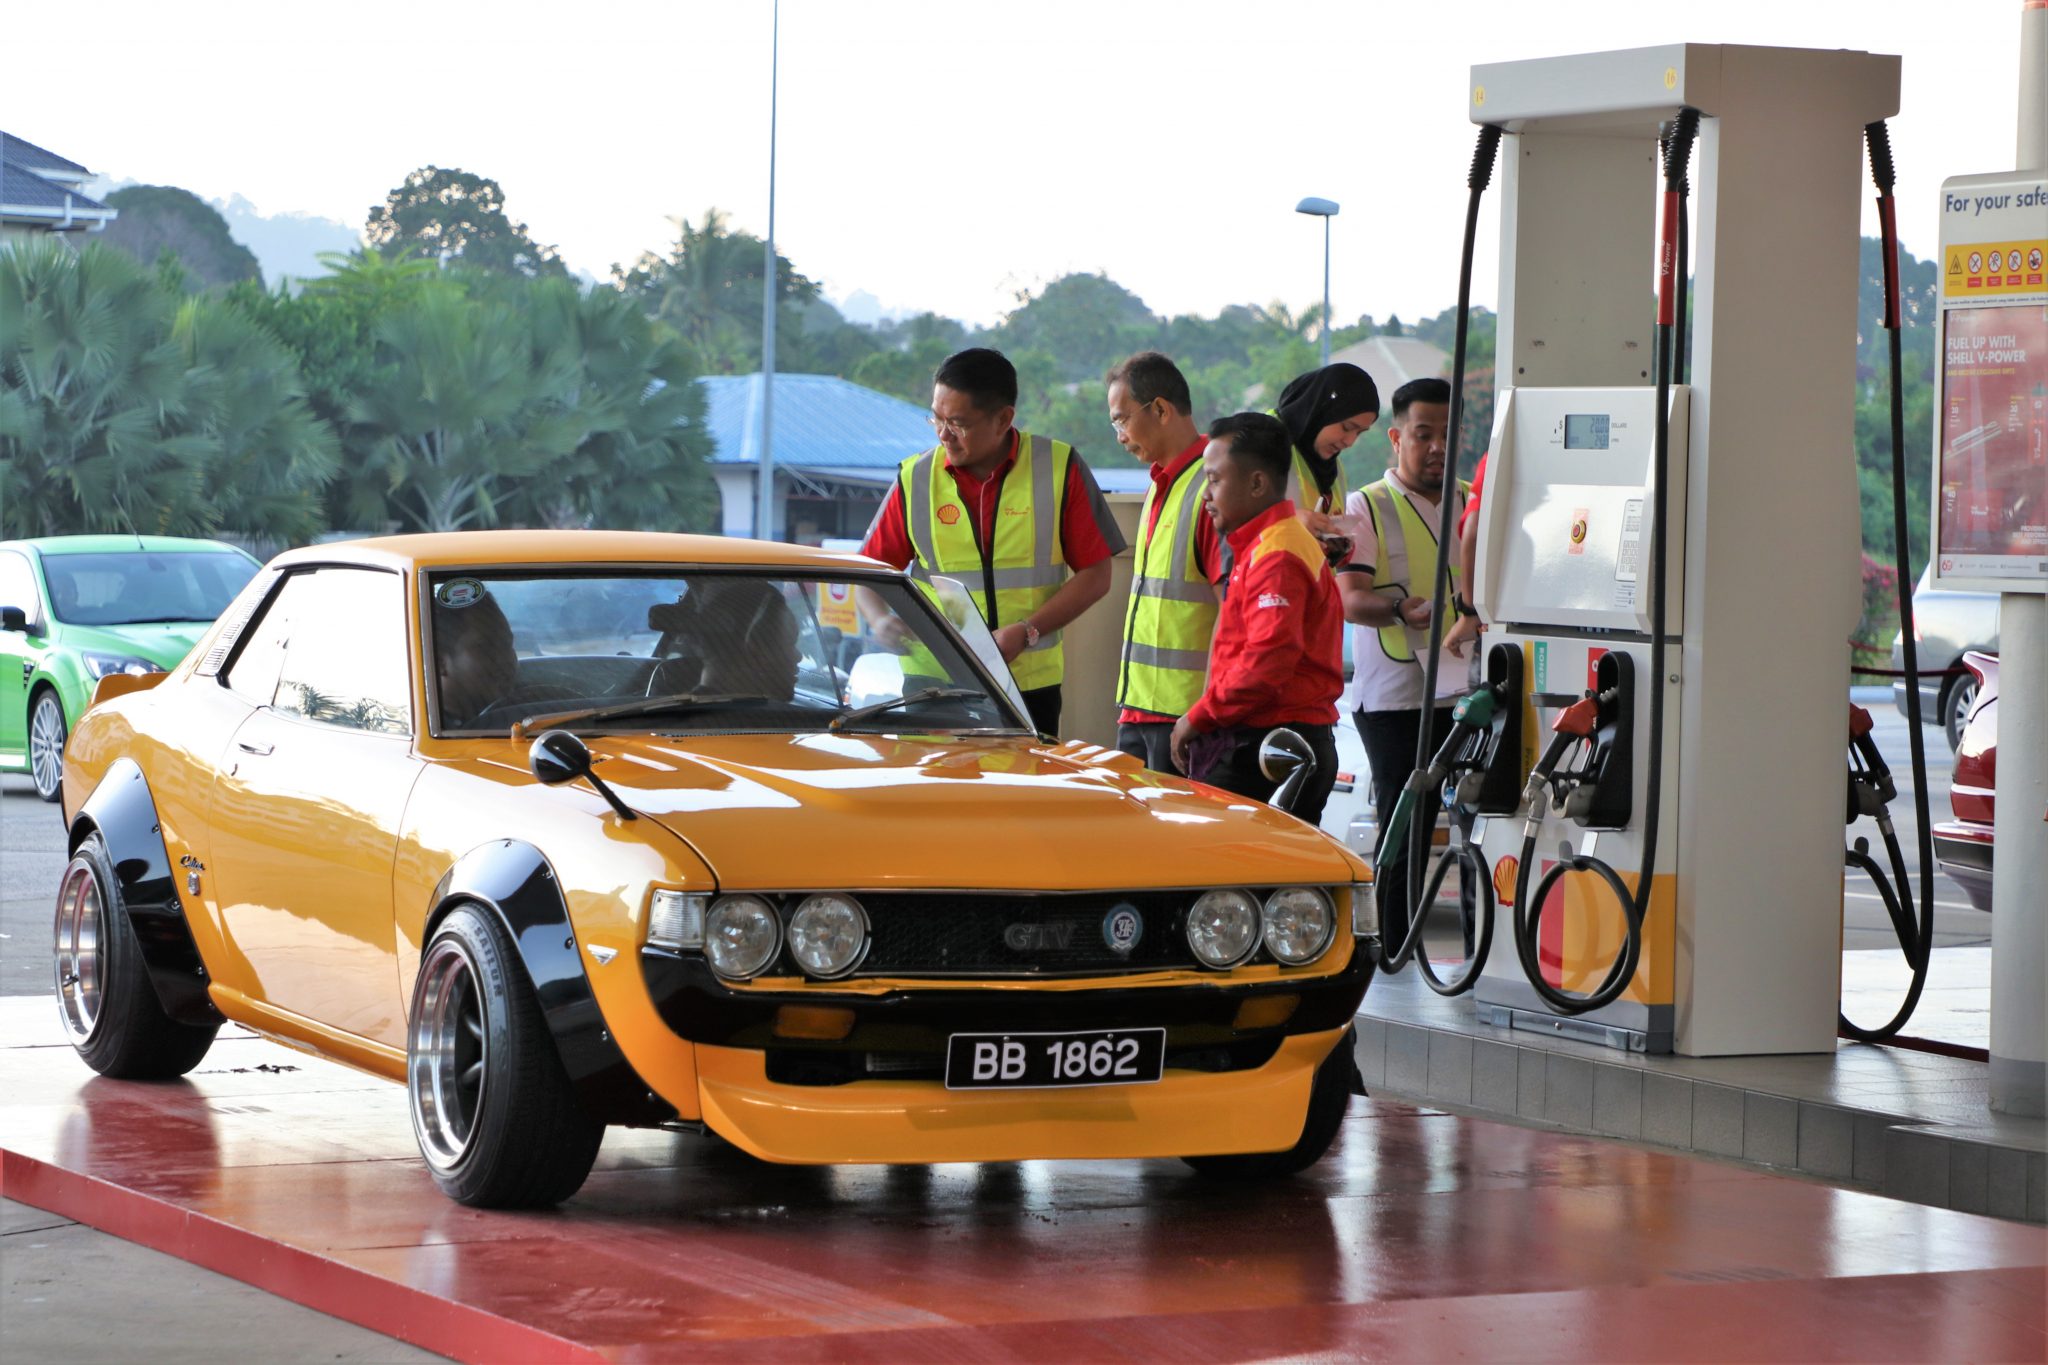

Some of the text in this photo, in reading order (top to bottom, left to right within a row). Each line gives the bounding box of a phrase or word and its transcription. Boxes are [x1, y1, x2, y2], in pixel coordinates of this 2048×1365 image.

[1946, 194, 1970, 212] For
[1974, 195, 2011, 216] your
[1948, 335, 2016, 350] FUEL UP WITH
[1947, 350, 2026, 365] SHELL V-POWER
[1005, 922, 1077, 950] GTV
[473, 926, 503, 997] SAILUN
[973, 1039, 1139, 1080] BB 1862
